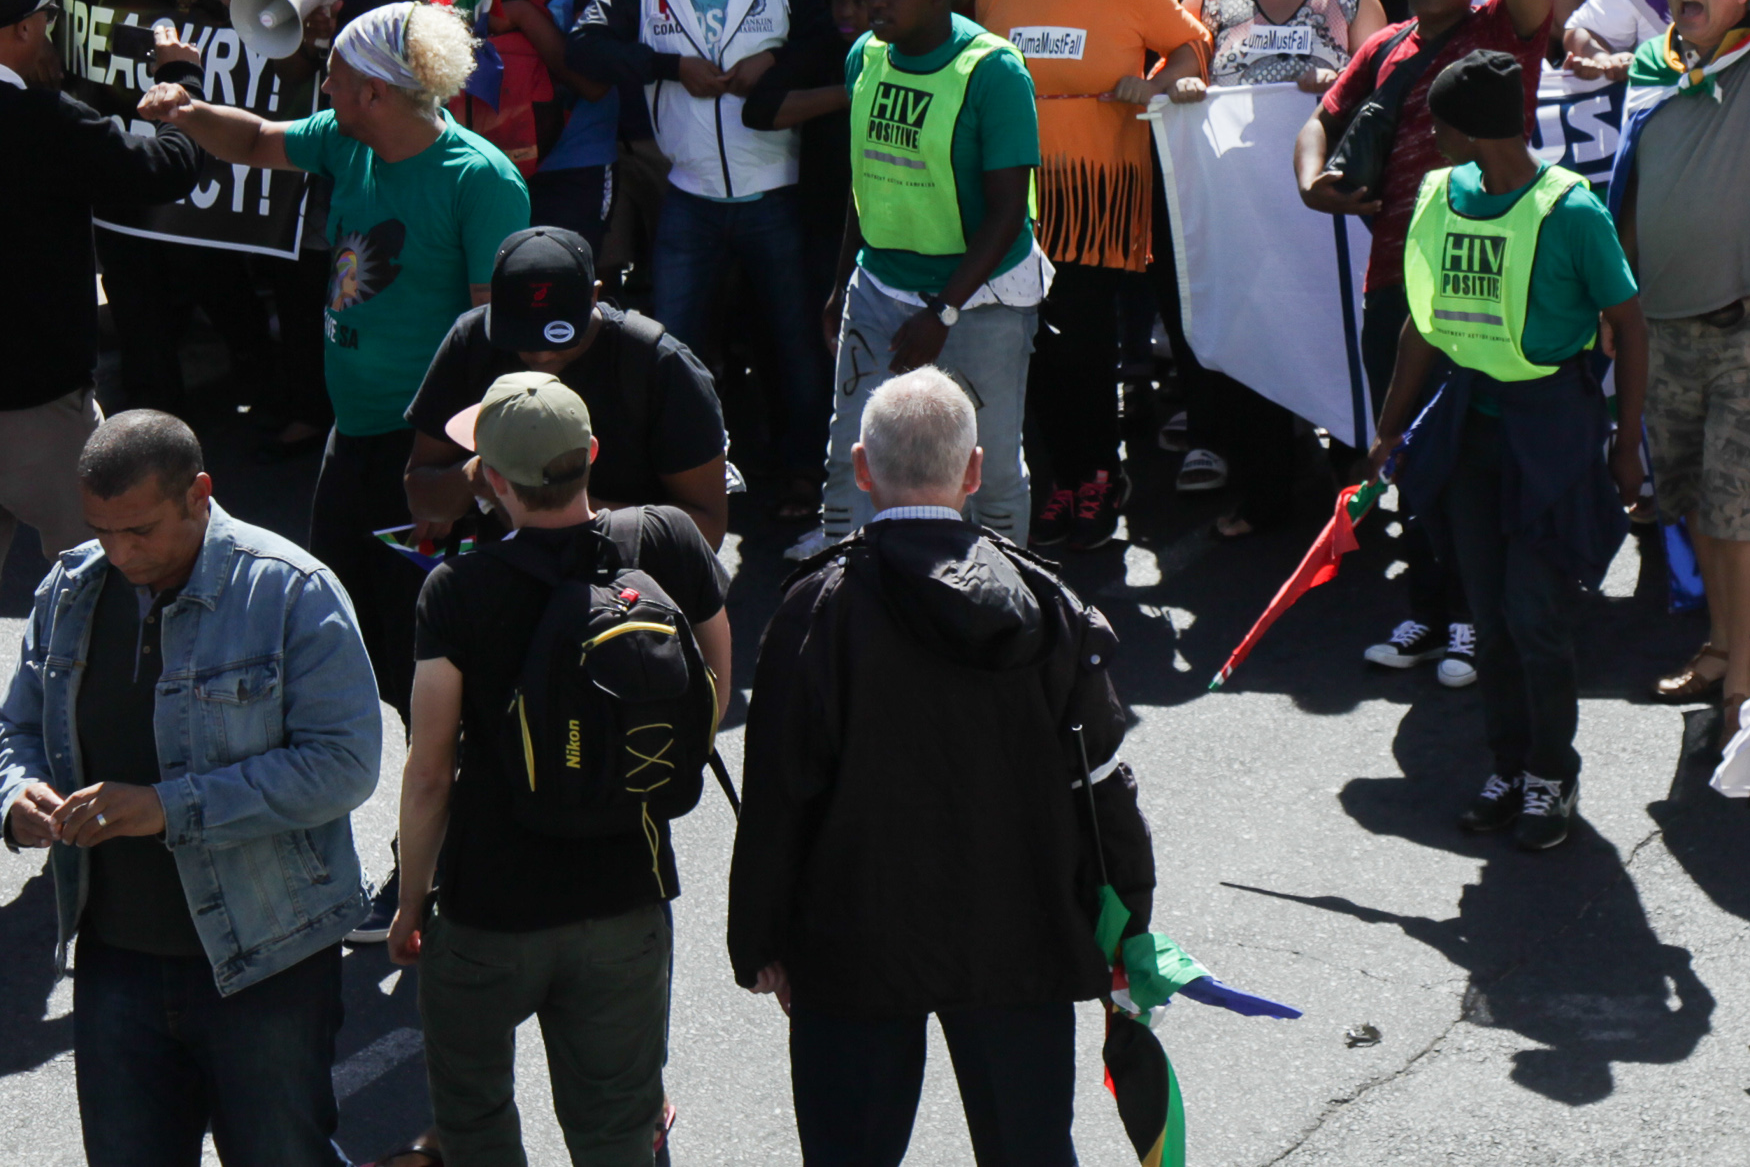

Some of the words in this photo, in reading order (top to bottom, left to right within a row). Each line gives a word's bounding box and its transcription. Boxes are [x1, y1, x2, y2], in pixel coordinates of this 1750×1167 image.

[652, 21, 685, 36] COAC
[872, 84, 931, 125] HIV
[868, 120, 920, 150] POSITIVE
[1444, 235, 1506, 274] HIV
[339, 327, 359, 351] SA
[566, 719, 581, 769] Nikon
